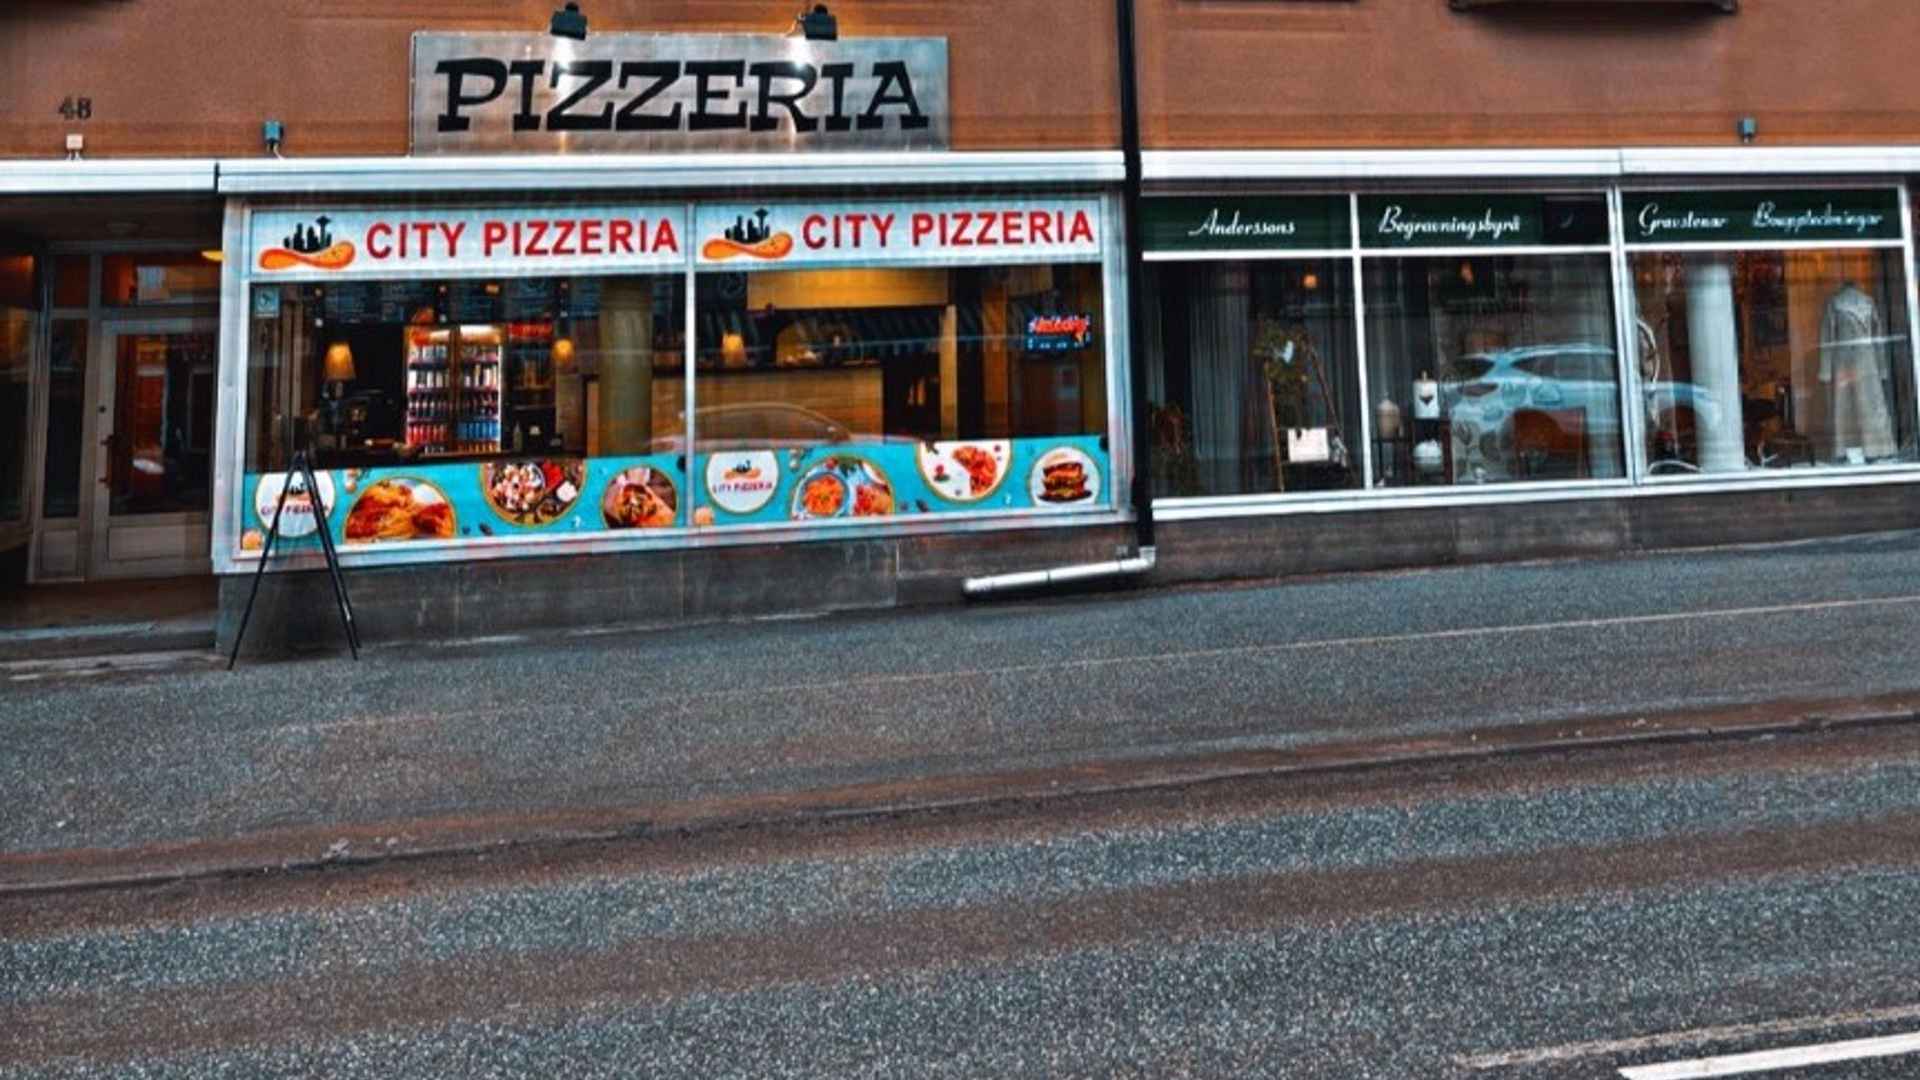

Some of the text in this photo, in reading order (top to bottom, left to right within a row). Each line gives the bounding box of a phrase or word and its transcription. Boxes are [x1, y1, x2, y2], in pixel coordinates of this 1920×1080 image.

[58, 97, 92, 120] 48
[435, 57, 929, 132] PIZZERIA
[366, 218, 679, 259] CITY PIZZERIA
[803, 210, 1095, 250] CITY PIZZERIA
[1187, 207, 1296, 236] Anderssons
